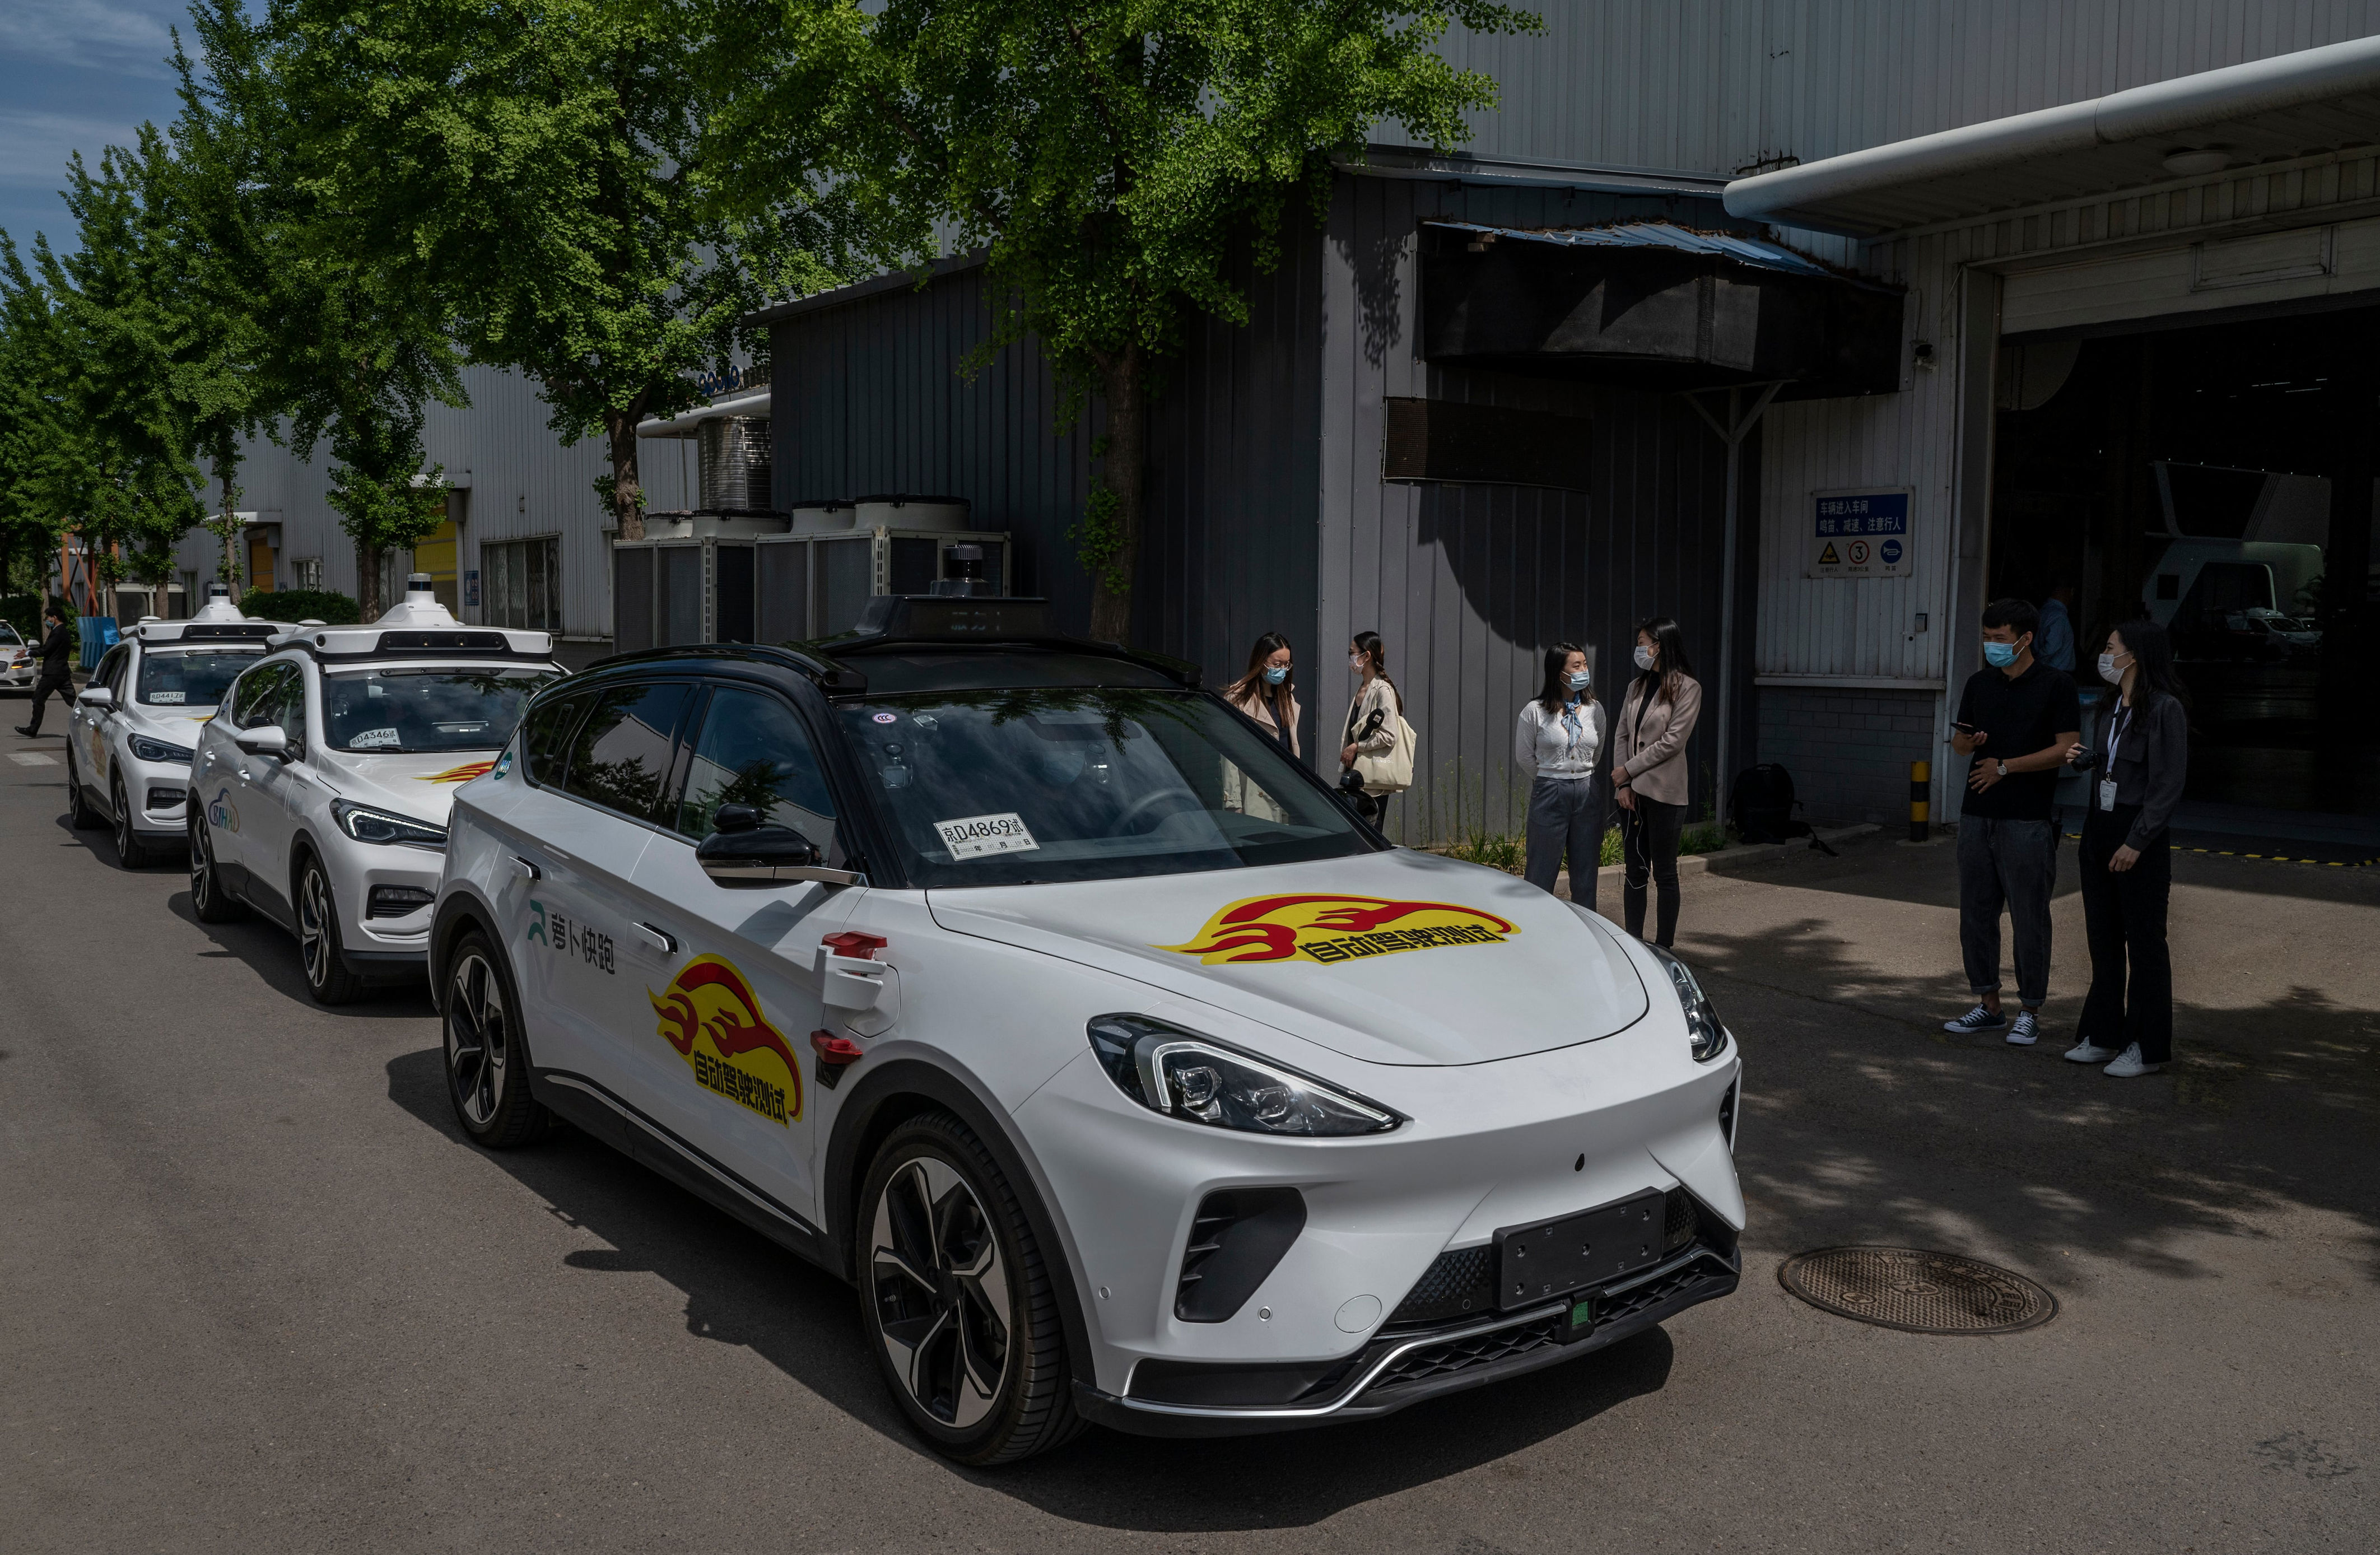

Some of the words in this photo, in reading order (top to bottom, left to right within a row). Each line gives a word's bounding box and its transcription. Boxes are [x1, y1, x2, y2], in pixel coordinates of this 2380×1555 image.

[1820, 500, 1869, 515] 车辆进入车间
[1856, 546, 1862, 560] 3
[942, 818, 1023, 842] 京D4869试
[551, 912, 615, 975] 萝卜快跑
[1297, 924, 1506, 963] 自动驾驶测试
[693, 1050, 787, 1124] 自动驾驶测试
